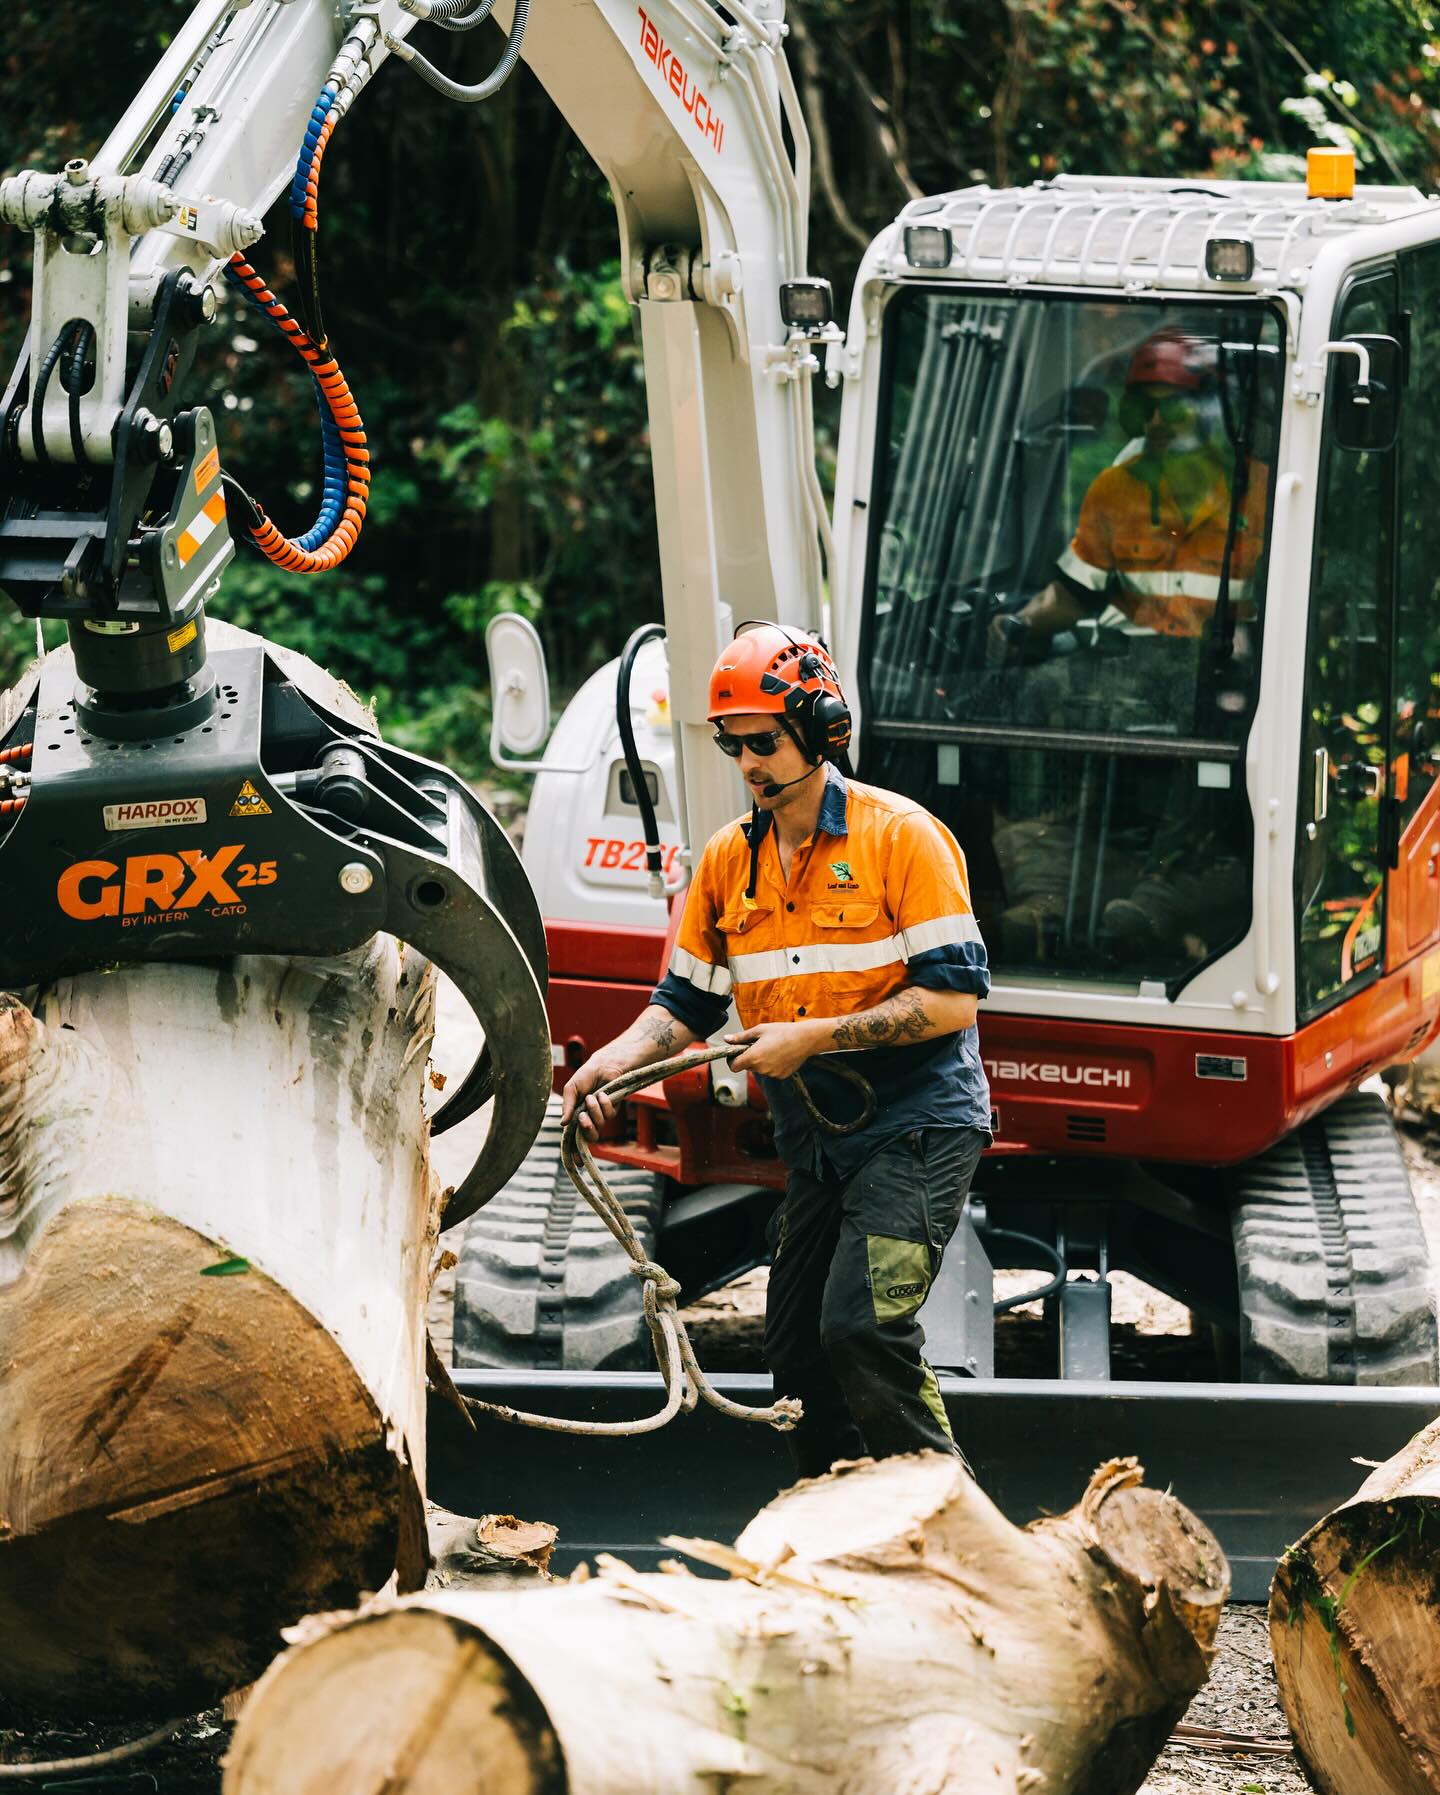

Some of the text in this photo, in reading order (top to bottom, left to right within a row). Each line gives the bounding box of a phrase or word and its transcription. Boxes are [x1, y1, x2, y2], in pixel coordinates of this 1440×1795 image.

[117, 800, 198, 821] HARDOX
[585, 839, 679, 873] TB2
[57, 844, 278, 920] GRX 25
[121, 905, 247, 927] BY INTERCATO
[886, 1283, 925, 1299] CLOGG
